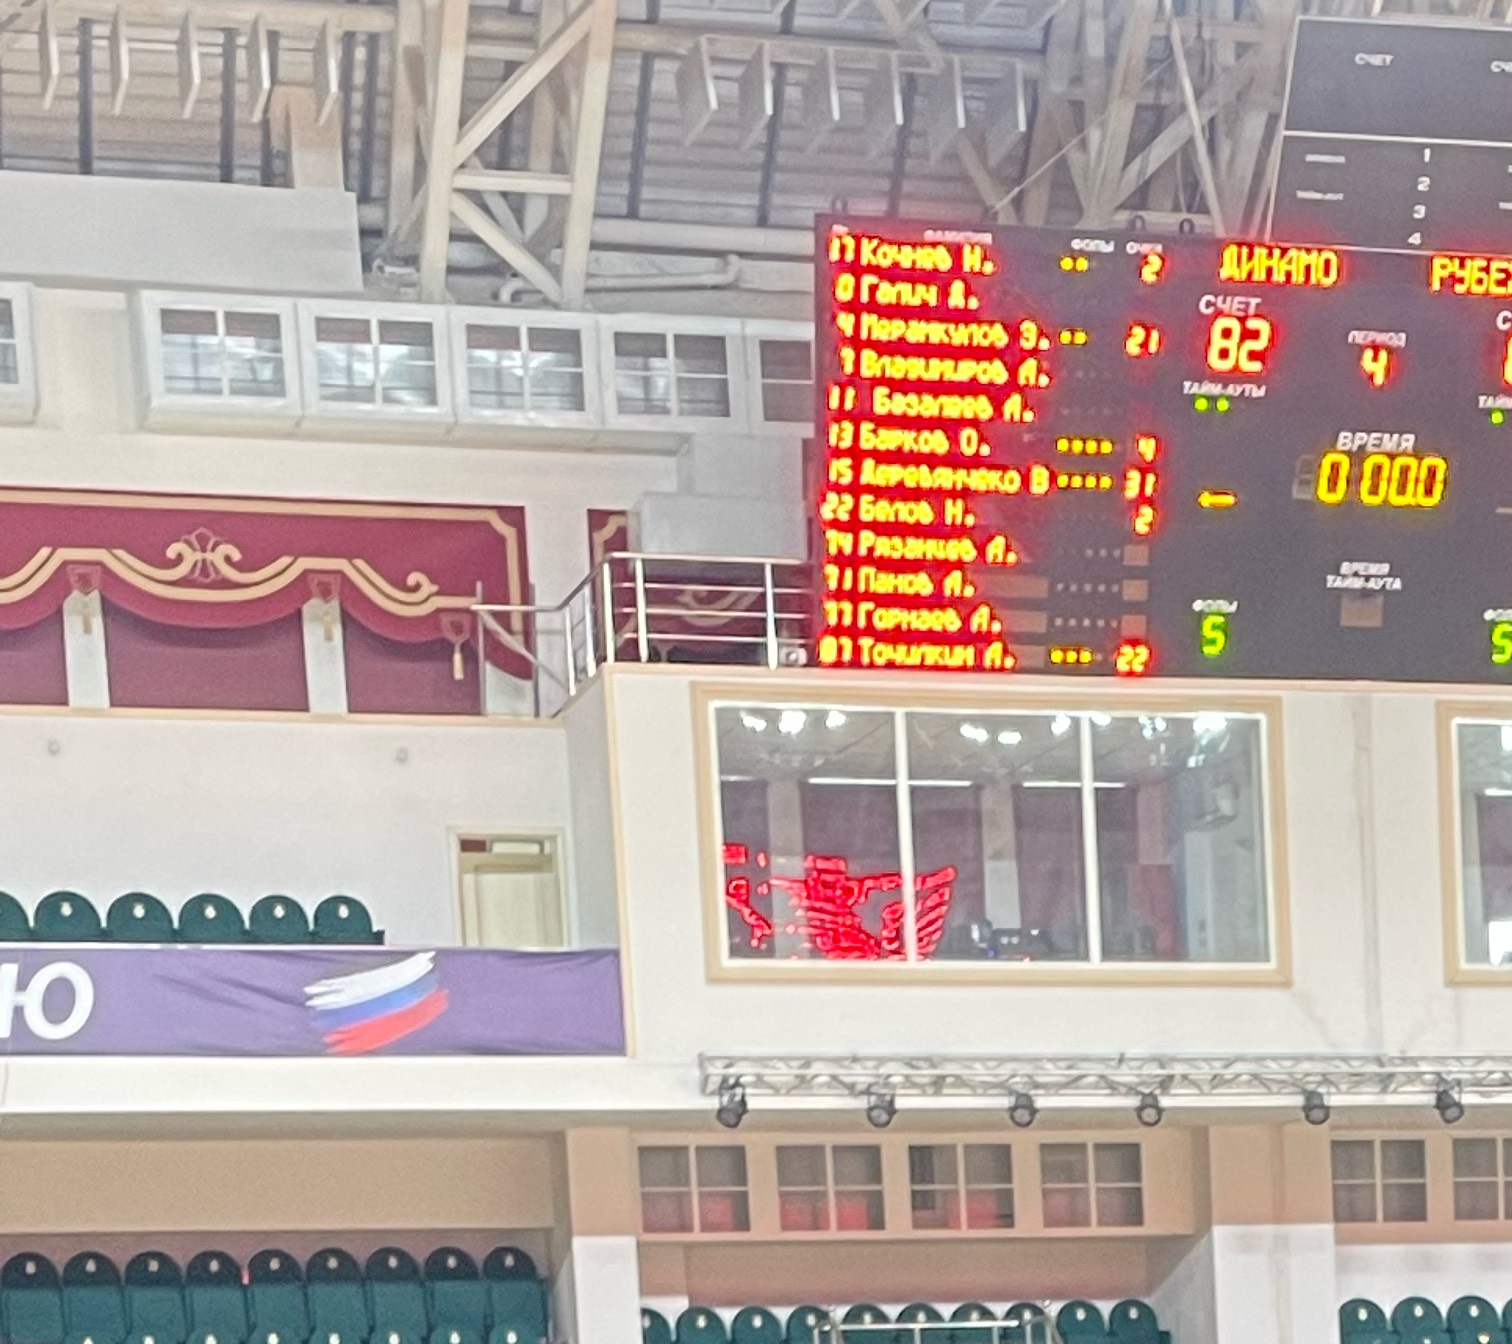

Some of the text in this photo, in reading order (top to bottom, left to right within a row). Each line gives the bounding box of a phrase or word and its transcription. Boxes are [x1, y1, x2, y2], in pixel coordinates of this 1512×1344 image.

[1424, 148, 1431, 162] 1
[1417, 176, 1430, 191] 2
[1413, 205, 1426, 219] 3
[1408, 232, 1422, 245] 4
[1141, 254, 1164, 283] 2
[1220, 244, 1340, 287] ДИНАМО
[1199, 295, 1261, 316] СЧЕТ
[836, 312, 855, 337] 4
[1126, 325, 1160, 356] 21
[1207, 316, 1271, 372] 82
[1348, 330, 1406, 348] ПЕРИОД
[1361, 349, 1388, 386] 4
[1336, 432, 1415, 452] ВРЕМЯ
[1124, 469, 1157, 499] 31
[821, 492, 854, 521] 22
[1135, 505, 1154, 534] 2
[1201, 614, 1227, 656] 5
[1115, 645, 1150, 672] 22
